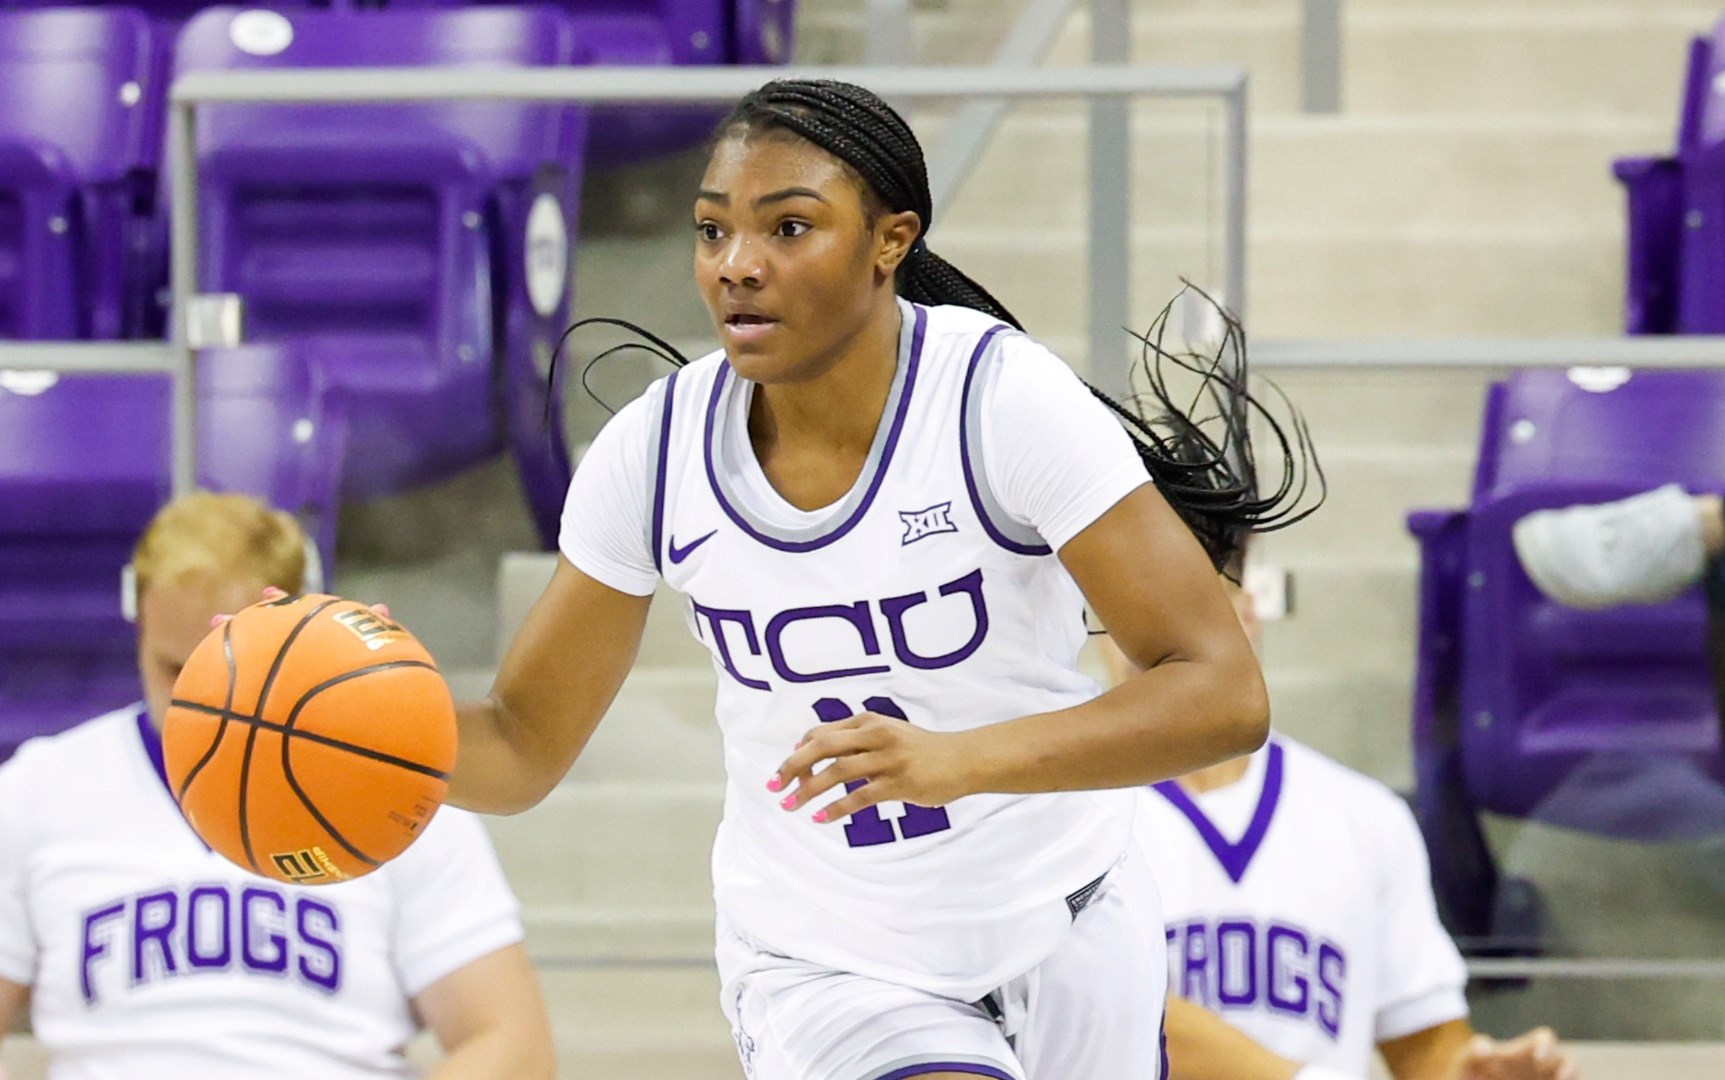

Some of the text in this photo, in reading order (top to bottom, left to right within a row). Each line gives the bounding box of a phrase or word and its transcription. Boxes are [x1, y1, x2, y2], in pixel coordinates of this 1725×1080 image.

[689, 568, 988, 691] TCU
[80, 886, 340, 1000] FROGS
[1166, 921, 1344, 1036] ROGS
